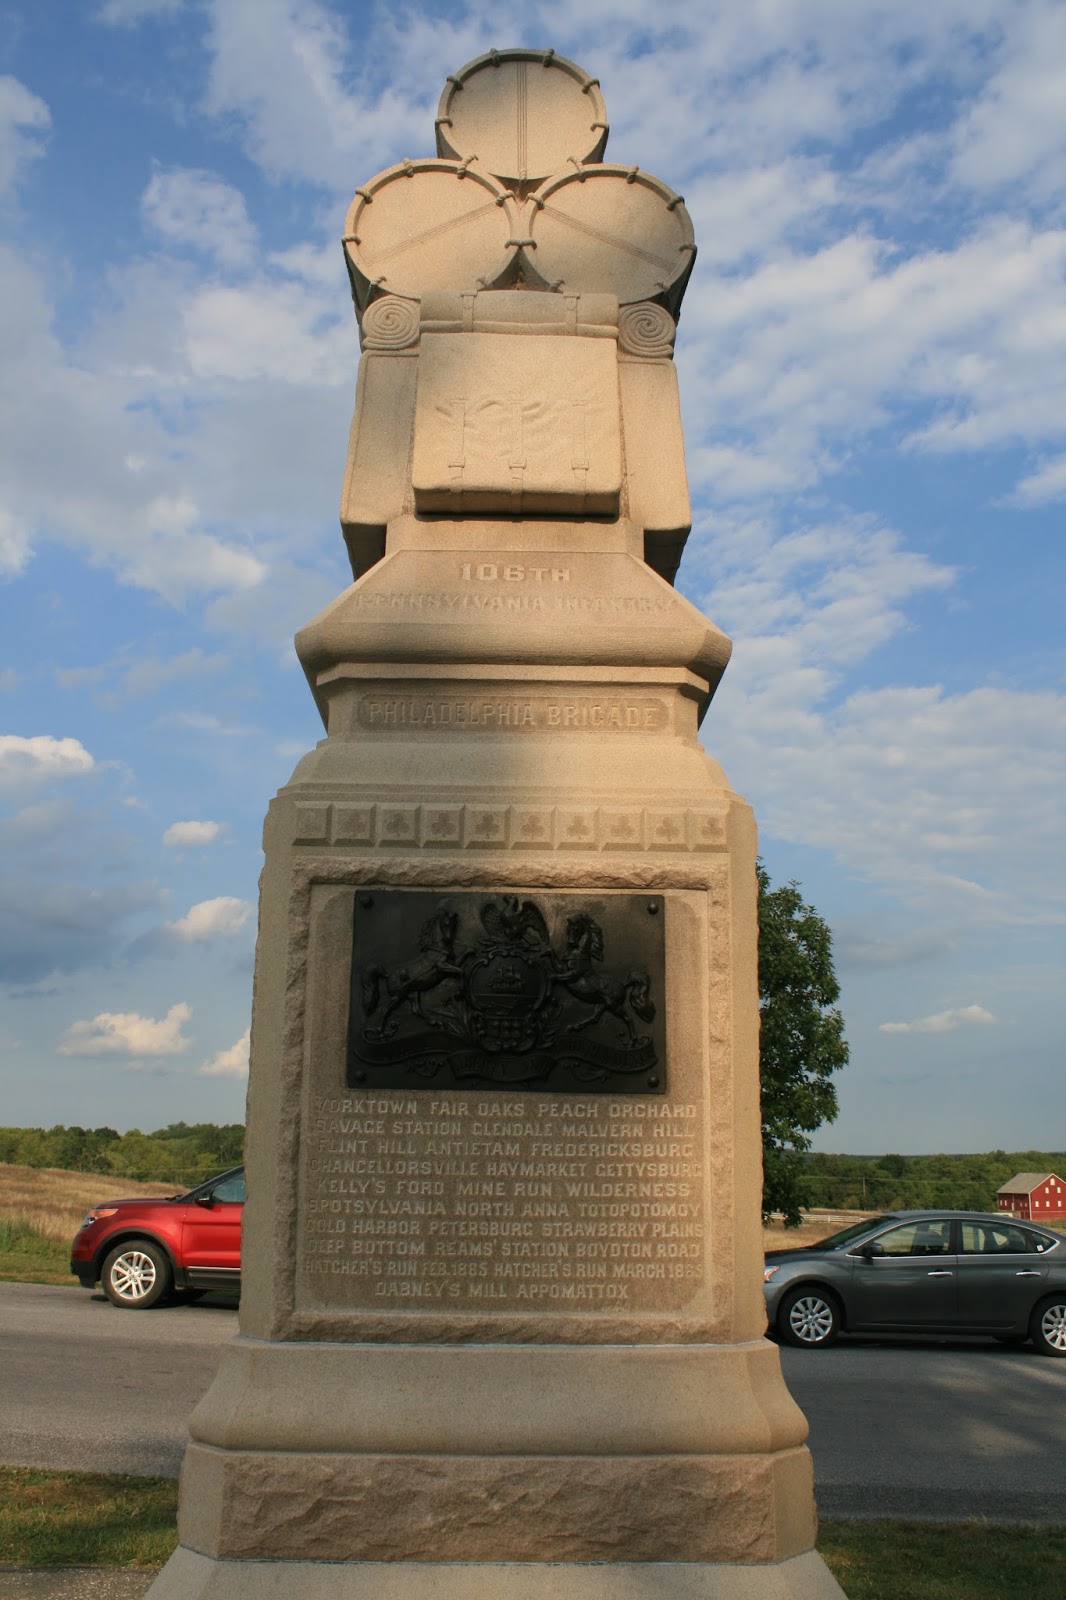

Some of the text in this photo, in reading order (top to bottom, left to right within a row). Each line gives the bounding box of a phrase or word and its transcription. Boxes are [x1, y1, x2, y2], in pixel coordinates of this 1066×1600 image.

[461, 562, 570, 582] 106TH
[354, 592, 545, 610] PENNSYLVANIA
[369, 701, 658, 727] PHILADELPHIA BRIGADE
[316, 1098, 696, 1118] YORKTOWN FAIR OAKS PEACH ORCHARD
[315, 1119, 695, 1138] SAVAGE STATION GLENDALE MALVERN HILL
[318, 1139, 693, 1158] FLINT HILL ANTIETAM FREDERICKSBURG
[310, 1159, 701, 1178] CHANCELLORSVILLE HAYMARKET GETTYSBURG
[318, 1178, 691, 1198] KELLY'S FORD MINE RUN WILDERNESS
[308, 1199, 700, 1218] SPOTSYLVANIA NORTH ANNA TOTOPOTOMOY
[306, 1219, 703, 1238] COLD HARBOR PETERSBURG STRAWBERRY PLAINS
[307, 1239, 345, 1254] DEEP
[352, 1240, 425, 1256] BOTTOM
[501, 1242, 569, 1257] STATION
[576, 1243, 651, 1258] BOYDTON
[656, 1243, 700, 1258] ROAD
[304, 1258, 382, 1276] HATCHER'S
[387, 1261, 417, 1276] RUN
[493, 1260, 572, 1278] HATCHER'S
[576, 1263, 607, 1278] RUN
[612, 1263, 665, 1279] MARCH
[375, 1281, 629, 1299] DABNEY'S MILL APPOMATTOX
